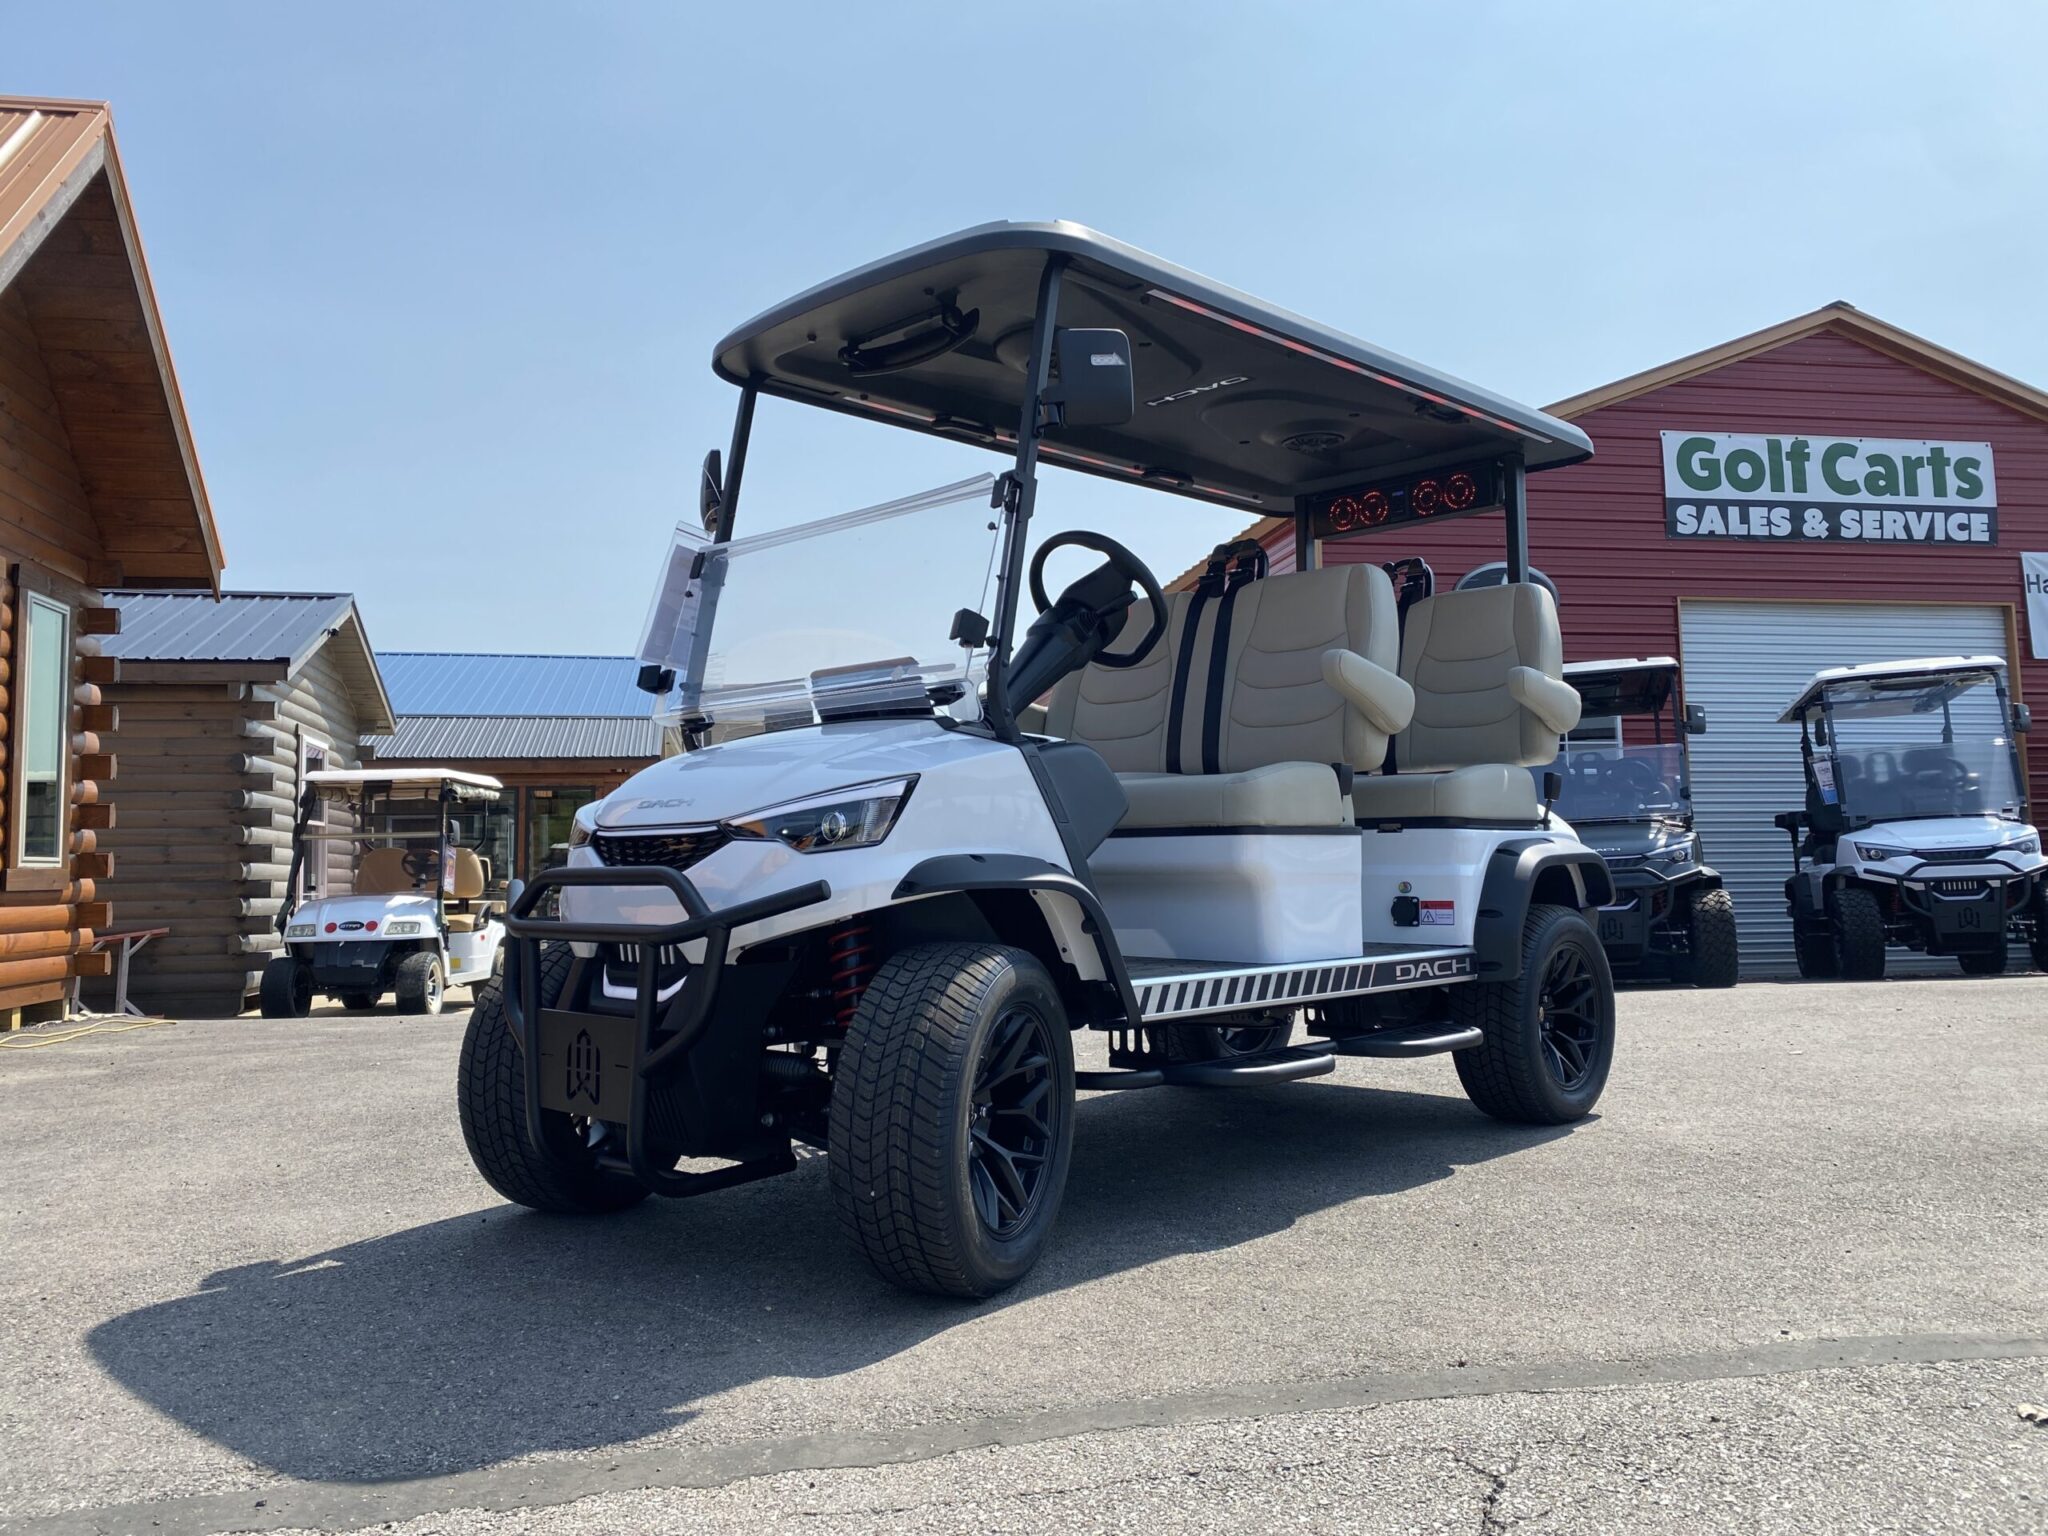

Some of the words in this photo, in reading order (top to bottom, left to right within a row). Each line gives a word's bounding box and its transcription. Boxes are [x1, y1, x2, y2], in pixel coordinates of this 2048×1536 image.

[1676, 436, 1811, 494] Golf
[1821, 442, 1984, 500] Carts
[1676, 504, 1792, 537] SALES
[1802, 507, 1830, 540] &
[1839, 509, 1990, 542] SERVICE
[1395, 958, 1470, 980] DACH
